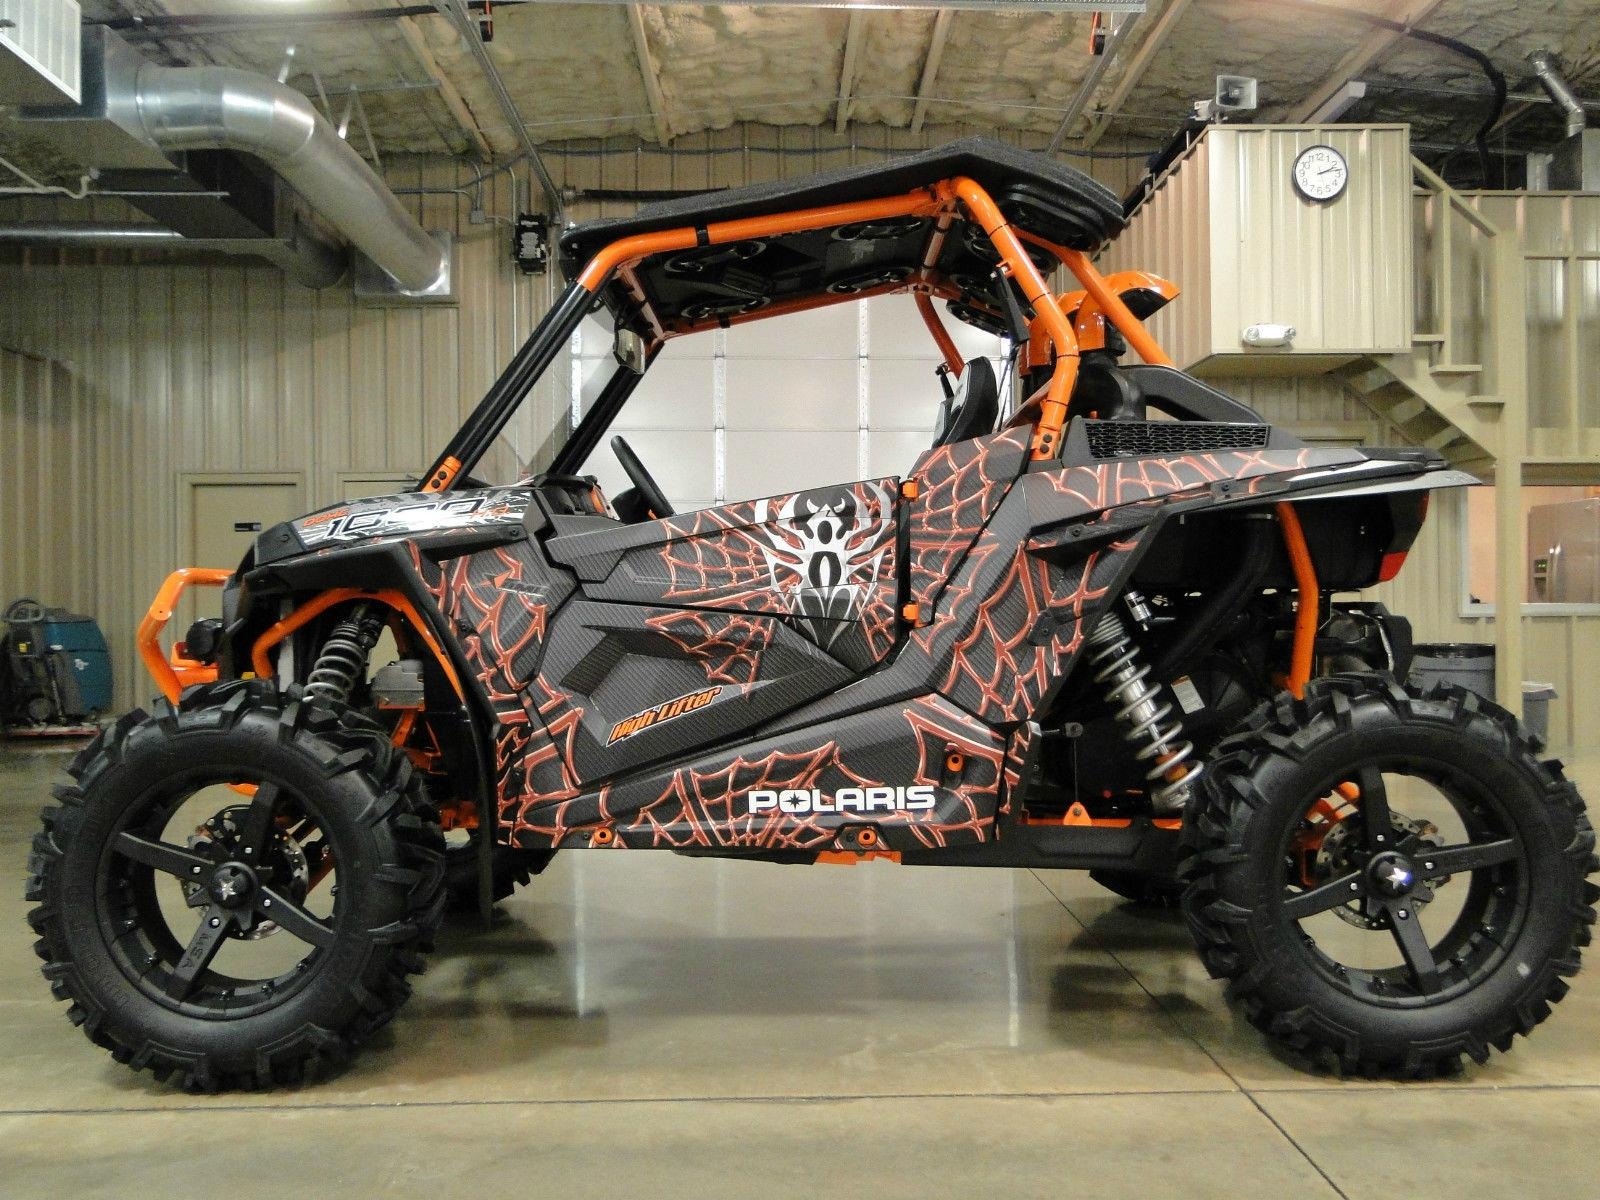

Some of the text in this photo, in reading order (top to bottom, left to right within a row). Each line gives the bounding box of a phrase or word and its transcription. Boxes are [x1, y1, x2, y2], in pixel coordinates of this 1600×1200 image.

[1315, 153, 1325, 161] 12
[1301, 161, 1311, 170] 10
[1332, 160, 1338, 169] 2
[1299, 169, 1306, 178] 9
[1302, 178, 1308, 187] 8
[1331, 179, 1338, 187] 4
[1310, 184, 1316, 192] 7
[1316, 187, 1323, 196] 6
[1325, 184, 1332, 193] 5
[606, 685, 723, 747] High Lifter
[748, 785, 936, 814] POLARIS
